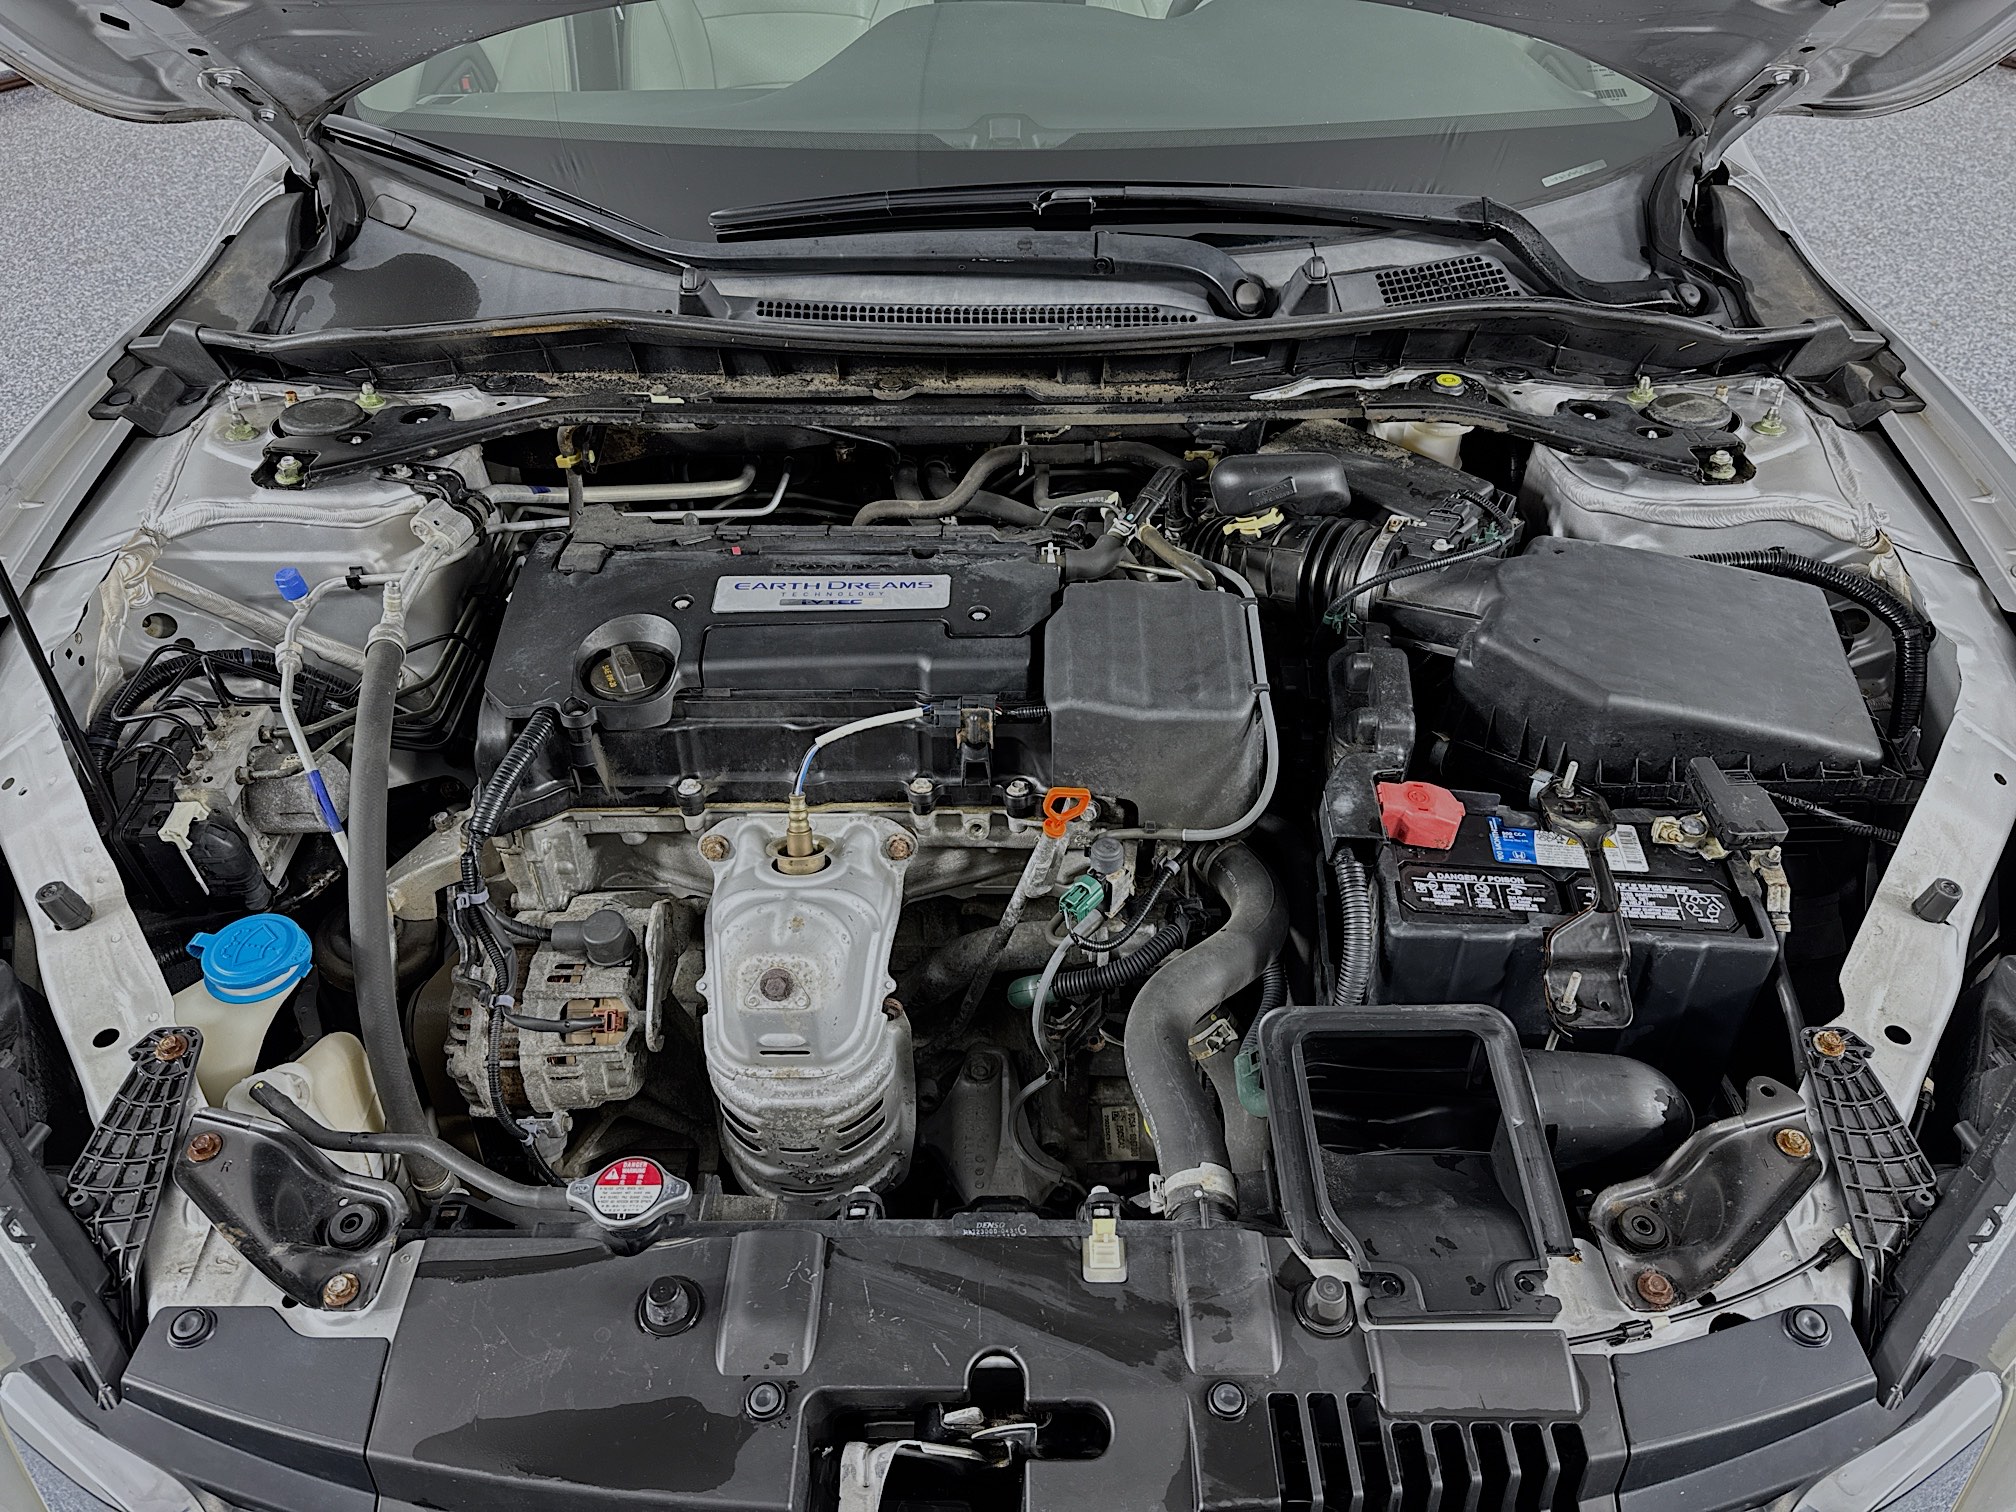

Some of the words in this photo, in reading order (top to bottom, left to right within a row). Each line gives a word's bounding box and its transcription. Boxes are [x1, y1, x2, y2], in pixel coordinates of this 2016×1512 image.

[773, 562, 898, 573] HONDA
[734, 582, 820, 590] EARTH
[827, 581, 933, 590] DREAMS
[1436, 873, 1478, 882] DANGER
[1487, 875, 1525, 884] POISON
[976, 1221, 1006, 1229] DENSO
